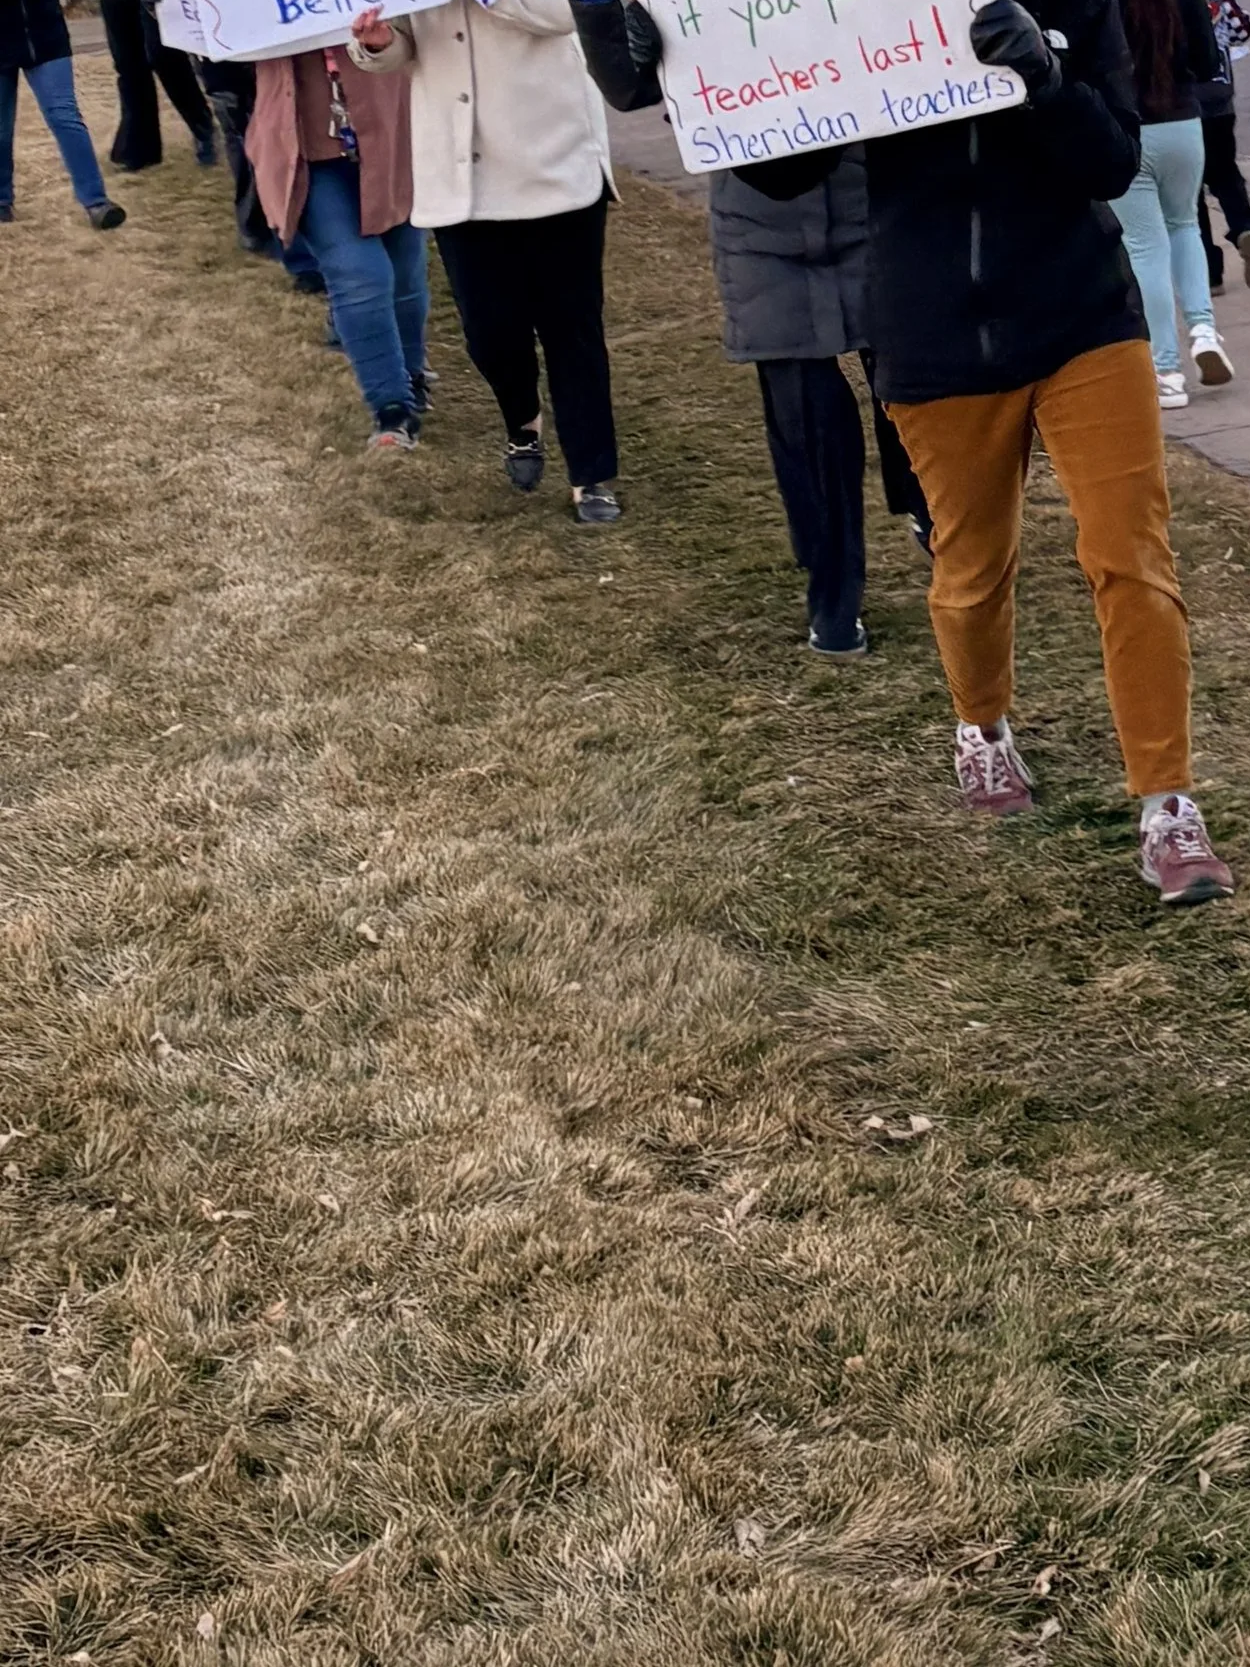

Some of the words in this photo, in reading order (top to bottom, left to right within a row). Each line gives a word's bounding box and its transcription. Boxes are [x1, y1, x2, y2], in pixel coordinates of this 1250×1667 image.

[692, 55, 842, 116] teachers
[857, 4, 954, 74] last!
[692, 106, 861, 165] Sheridan
[880, 70, 1016, 128] teachers
